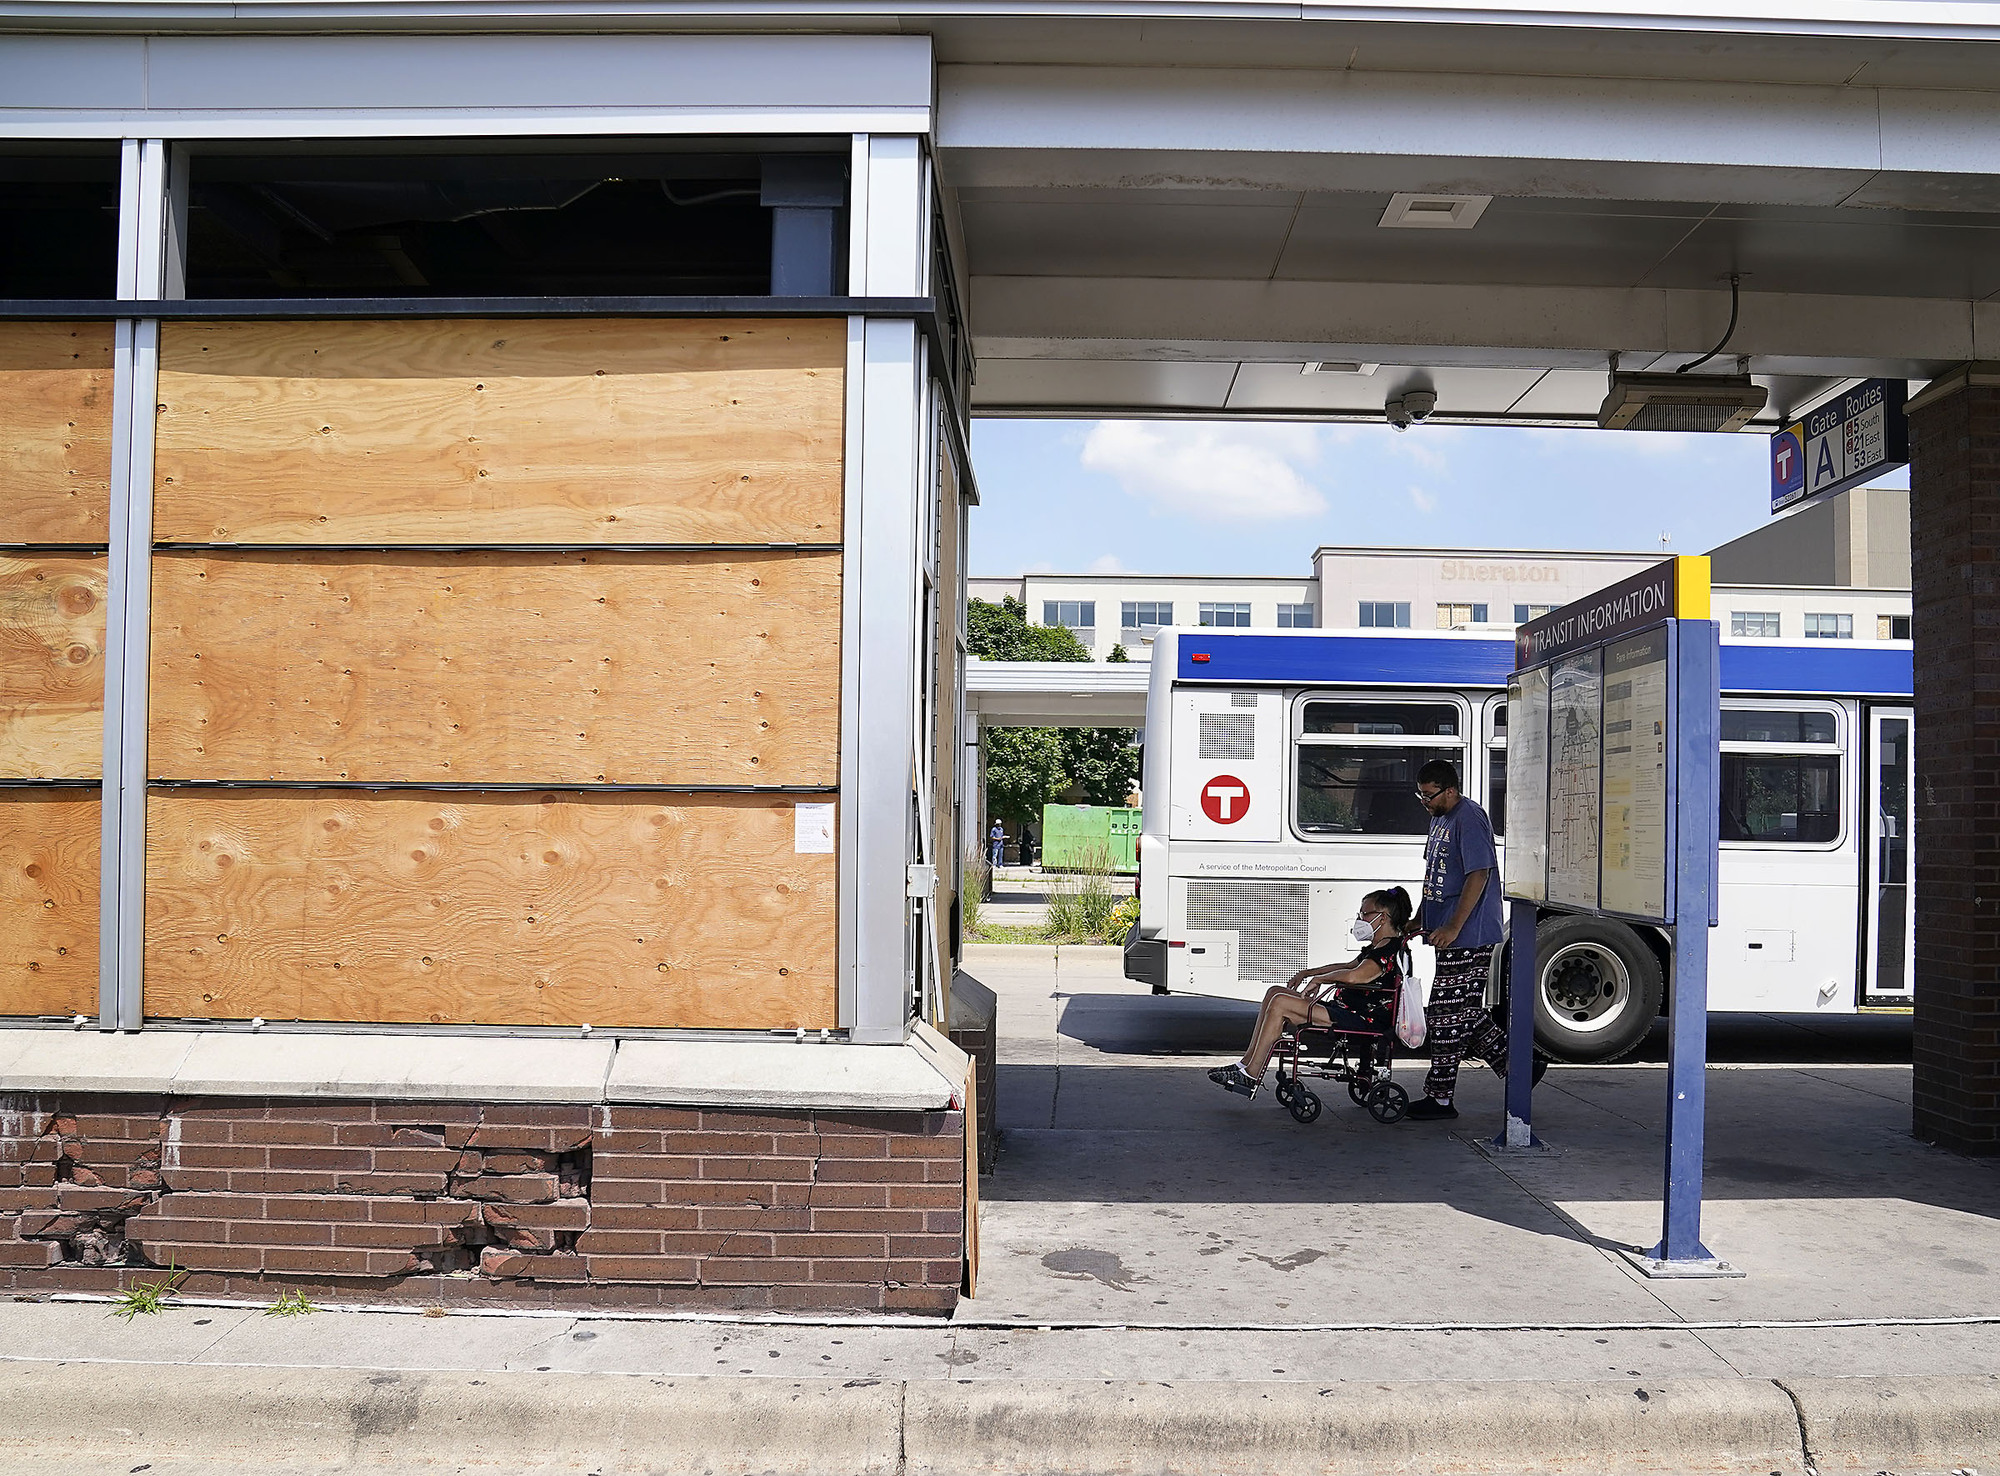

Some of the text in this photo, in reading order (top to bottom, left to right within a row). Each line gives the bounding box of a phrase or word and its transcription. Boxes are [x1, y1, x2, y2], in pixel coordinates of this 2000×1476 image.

[1810, 410, 1837, 436] Gate
[1845, 385, 1882, 418] Routes
[1853, 417, 1859, 434] 5
[1860, 412, 1880, 431] South
[1854, 433, 1864, 453] 21
[1865, 431, 1881, 447] East
[1776, 448, 1792, 480] T
[1814, 436, 1836, 487] A
[1854, 448, 1882, 469] 53 East
[1440, 560, 1560, 582] Sheraton
[1533, 617, 1575, 653] TRANSIT
[1577, 581, 1666, 638] INFORMATION
[1207, 786, 1244, 819] T
[1206, 863, 1231, 871] service
[1233, 863, 1241, 871] of
[1241, 863, 1253, 871] the
[1254, 863, 1298, 873] Metropolitan
[1300, 864, 1327, 872] Council
